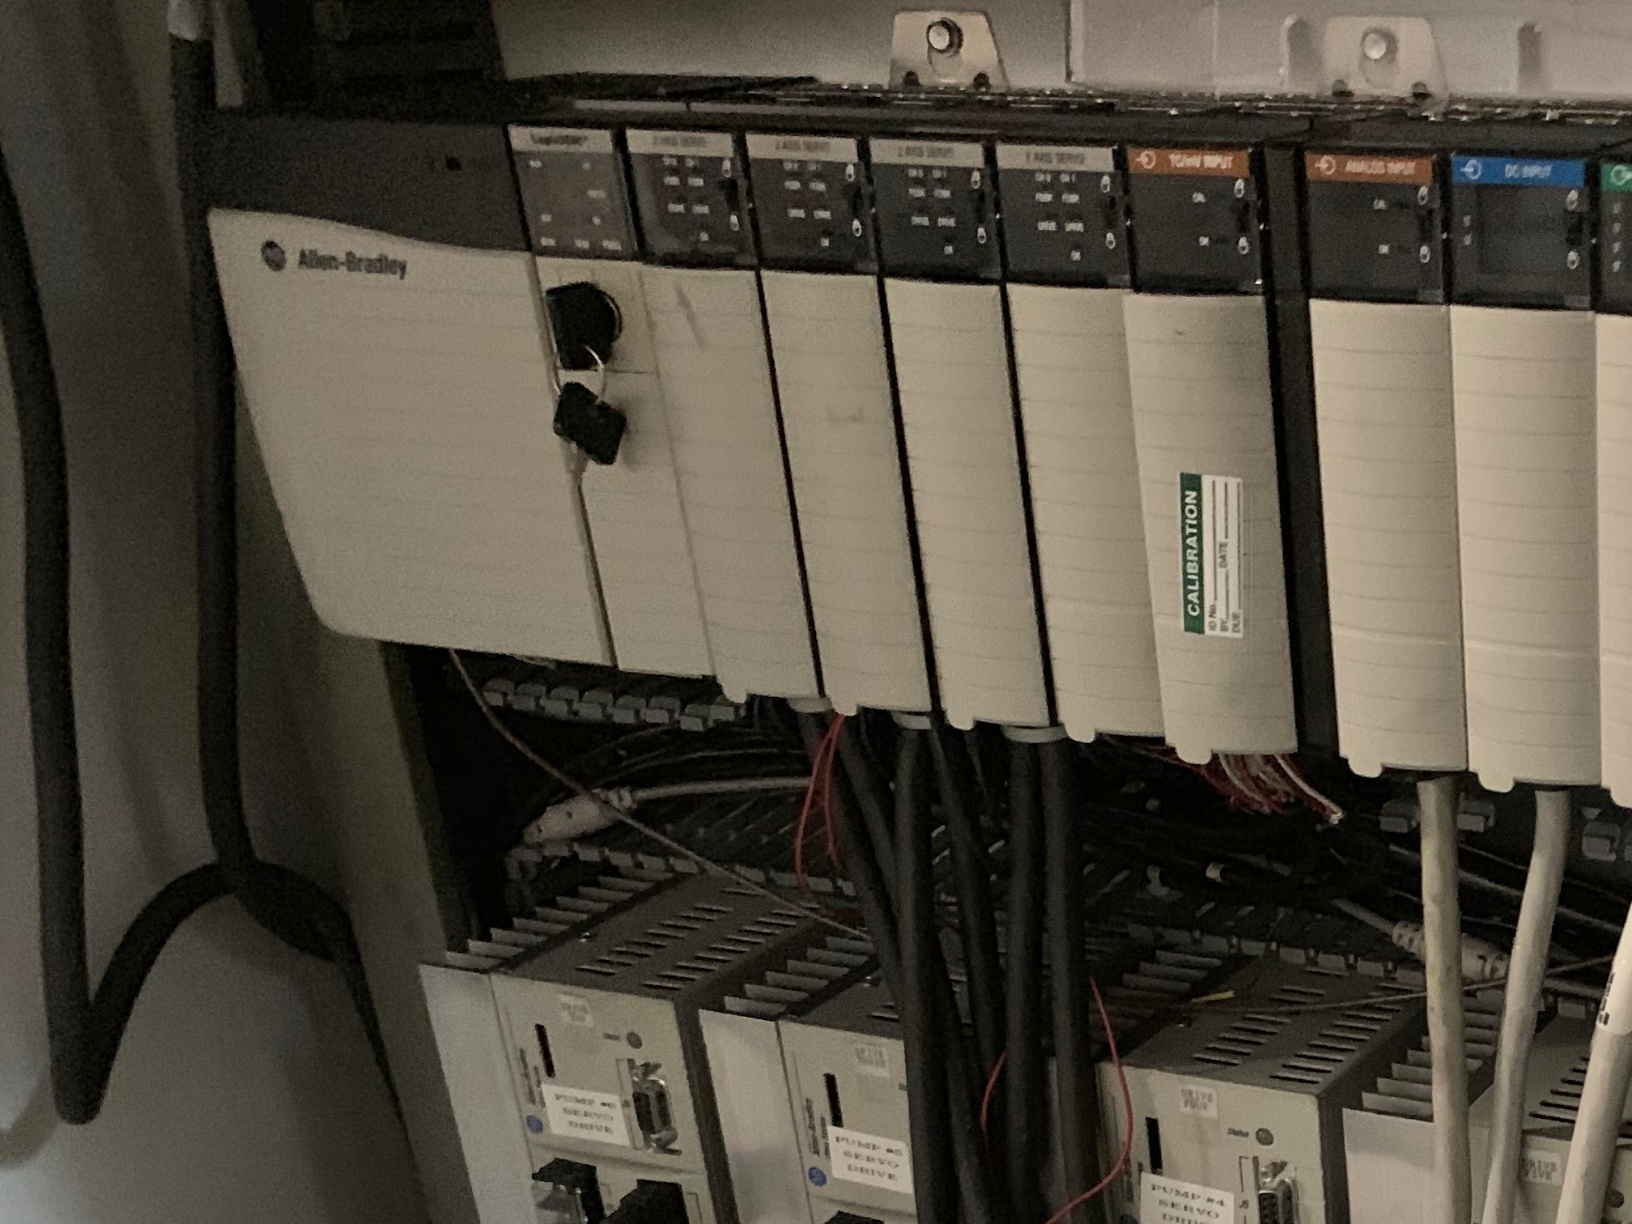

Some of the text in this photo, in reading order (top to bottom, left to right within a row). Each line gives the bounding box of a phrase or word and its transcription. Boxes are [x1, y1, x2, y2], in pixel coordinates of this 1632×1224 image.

[298, 248, 408, 281] Allen-Bradley
[1184, 490, 1201, 617] CALIBRATION
[1218, 541, 1229, 569] DATE
[1231, 612, 1241, 634] DUE
[562, 1106, 615, 1122] SERVO
[567, 1119, 615, 1135] DRIVE
[835, 1134, 882, 1151] PUMP
[842, 1150, 900, 1169] SERVO
[847, 1163, 899, 1182] DRIVE
[1151, 1183, 1226, 1208] PUMP #4
[1157, 1199, 1220, 1220] SERVO
